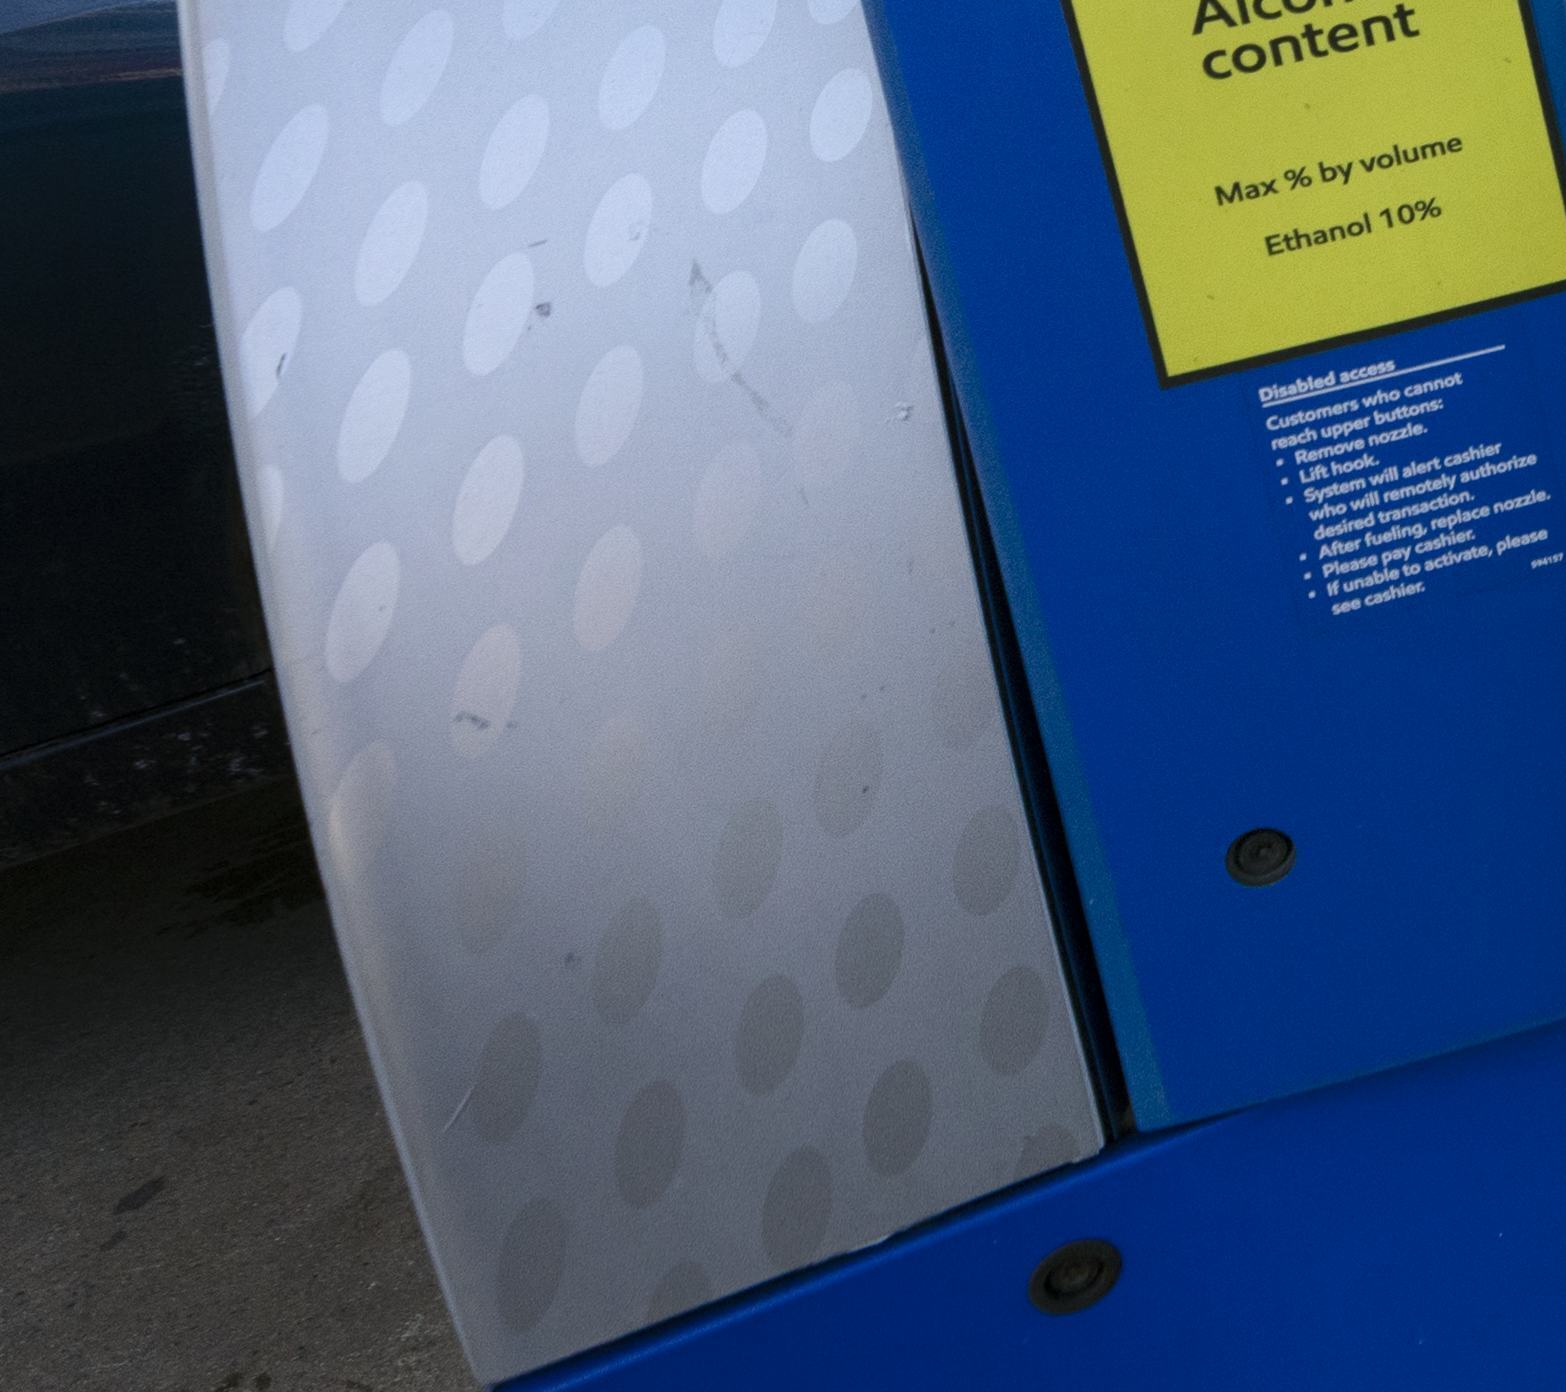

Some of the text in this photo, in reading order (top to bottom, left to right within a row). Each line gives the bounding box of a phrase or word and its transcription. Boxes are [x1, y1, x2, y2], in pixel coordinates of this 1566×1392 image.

[1201, 1, 1421, 81] content
[1215, 134, 1464, 207] Max % by volume
[1264, 197, 1443, 257] Ethanol 10%
[1259, 360, 1395, 402] Disabled access
[1266, 372, 1463, 431] Customers who cannot
[1271, 398, 1444, 450] reach upper buttons:
[1295, 423, 1428, 465] Remove nozzle.
[1300, 453, 1380, 484] Lift hook.
[1304, 442, 1502, 504] System will alert cashier
[1308, 454, 1537, 521] who will remotely authorize
[1314, 491, 1475, 540] desired transaction.
[1319, 489, 1551, 560] After fueling, replace nozzle.
[1322, 528, 1476, 578] Please pay cashier.
[1327, 529, 1548, 597] If unable to activate, please
[1331, 580, 1426, 615] see cashier.
